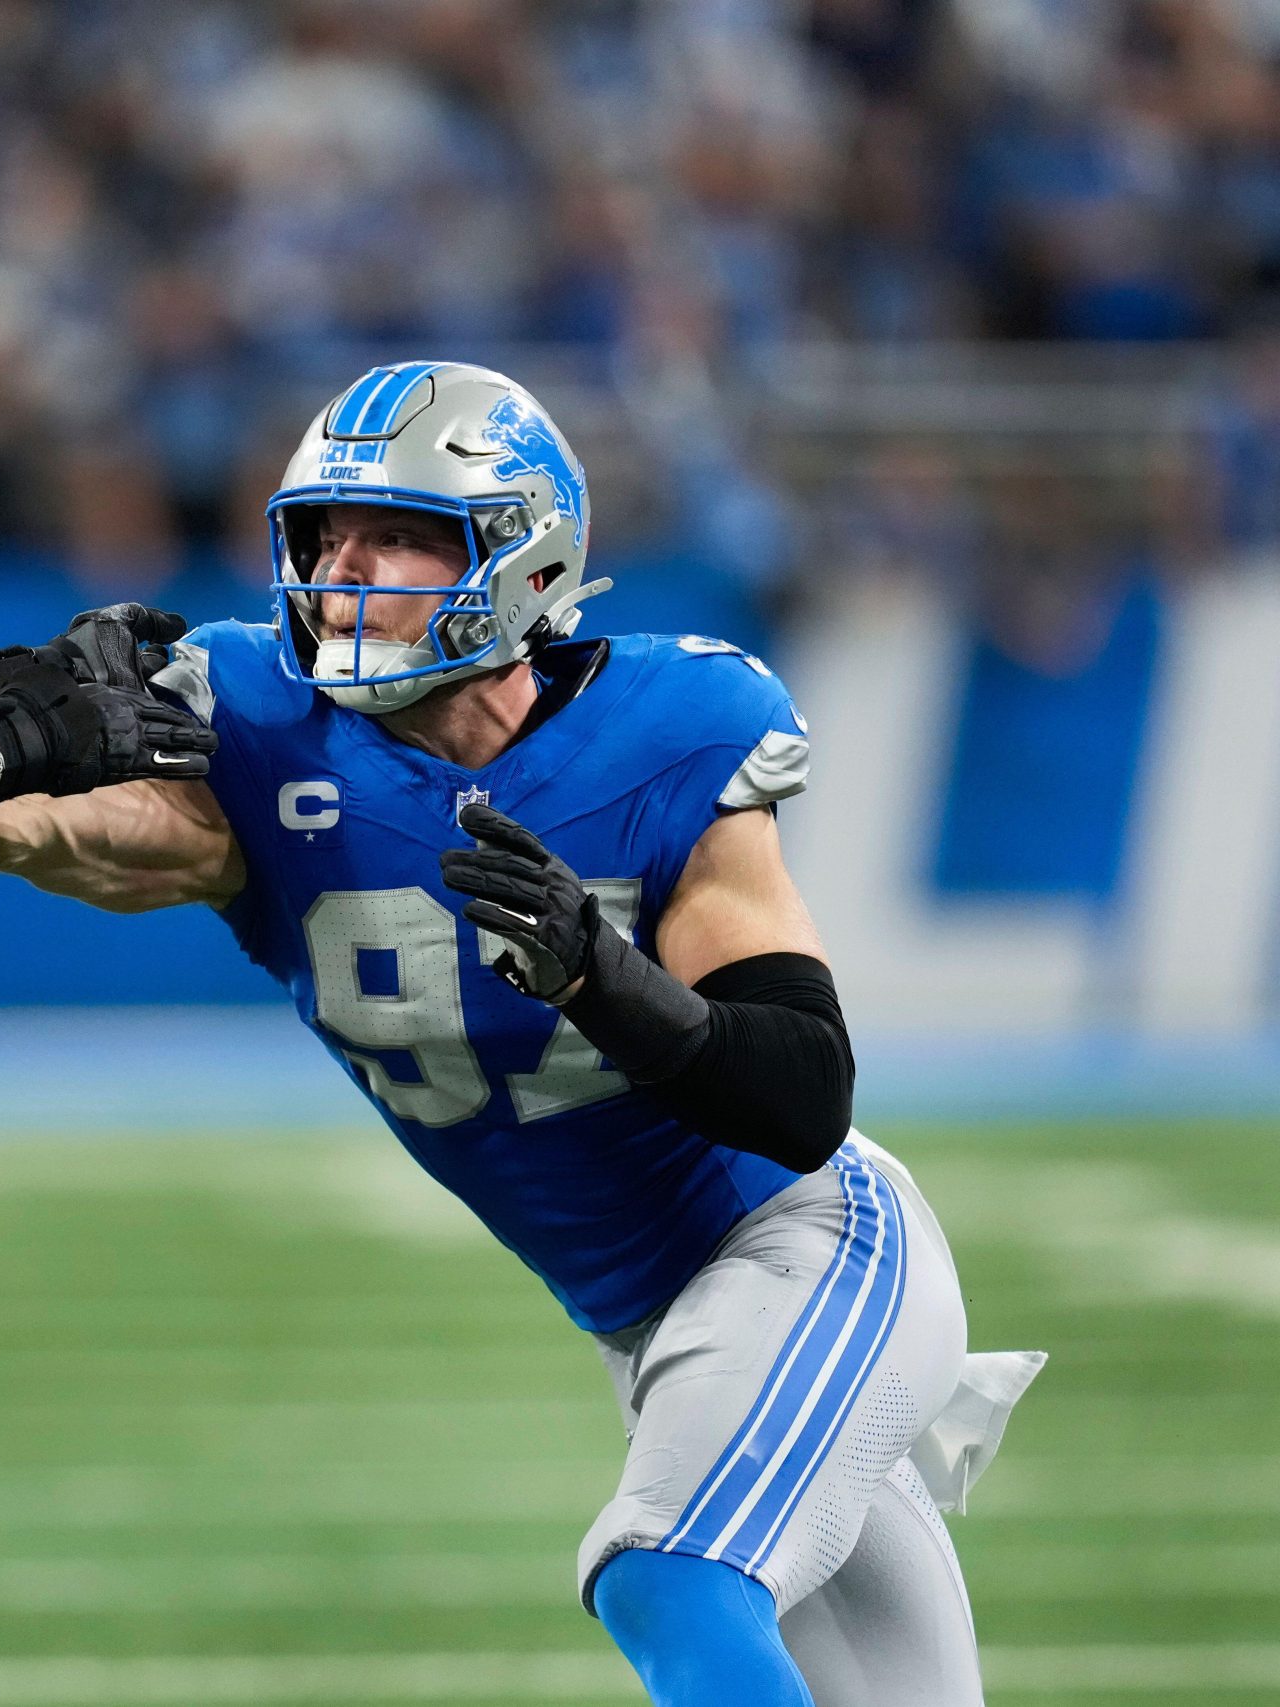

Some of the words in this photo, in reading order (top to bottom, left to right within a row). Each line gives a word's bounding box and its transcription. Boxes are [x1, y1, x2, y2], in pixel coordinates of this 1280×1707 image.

[319, 466, 363, 480] LIONS
[277, 780, 341, 831] C
[302, 878, 642, 1128] 97
